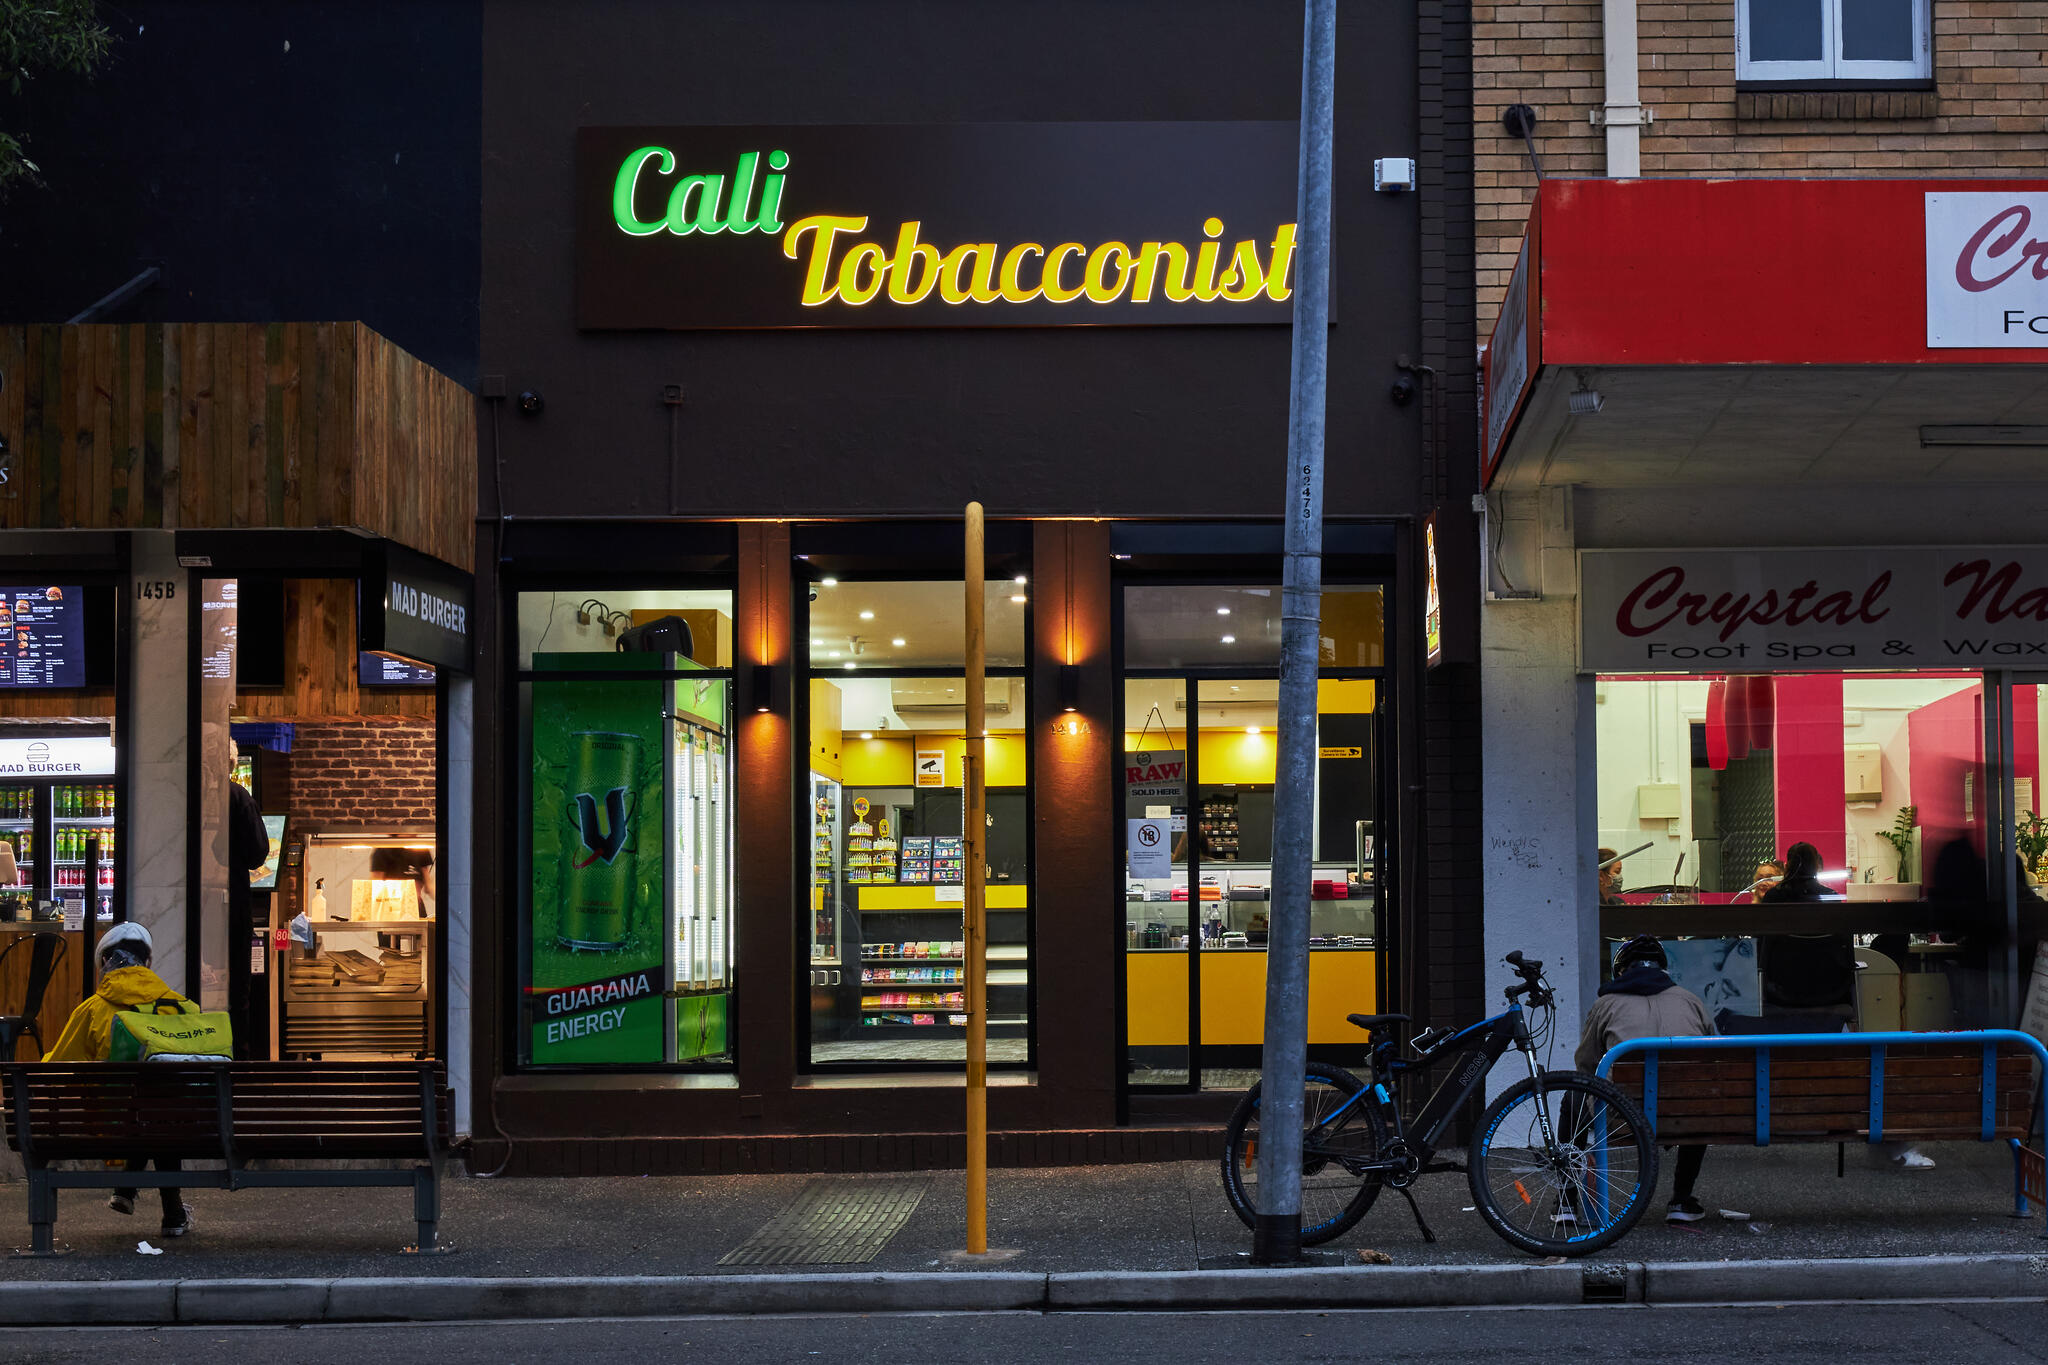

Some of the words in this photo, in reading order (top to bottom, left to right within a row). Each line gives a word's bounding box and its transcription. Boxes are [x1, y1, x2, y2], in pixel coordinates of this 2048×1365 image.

[612, 145, 788, 236] Cali
[783, 215, 1298, 306] Tobacconist
[1302, 464, 1312, 519] 62473
[137, 581, 176, 600] 145B
[392, 581, 418, 618] MAD
[421, 591, 466, 634] BURGER
[1616, 566, 1893, 643] Crystal
[1647, 643, 1750, 659] Foot
[1765, 641, 1856, 662] Spa
[1880, 640, 1915, 657] &
[28, 762, 82, 773] BURGER
[1126, 761, 1184, 784] RAW
[1131, 788, 1155, 797] SOLD
[1156, 788, 1181, 796] HERE
[276, 930, 287, 941] 80
[547, 974, 650, 1015] GUARANA
[547, 1007, 627, 1044] ENERGY
[1458, 1050, 1487, 1086] NCM
